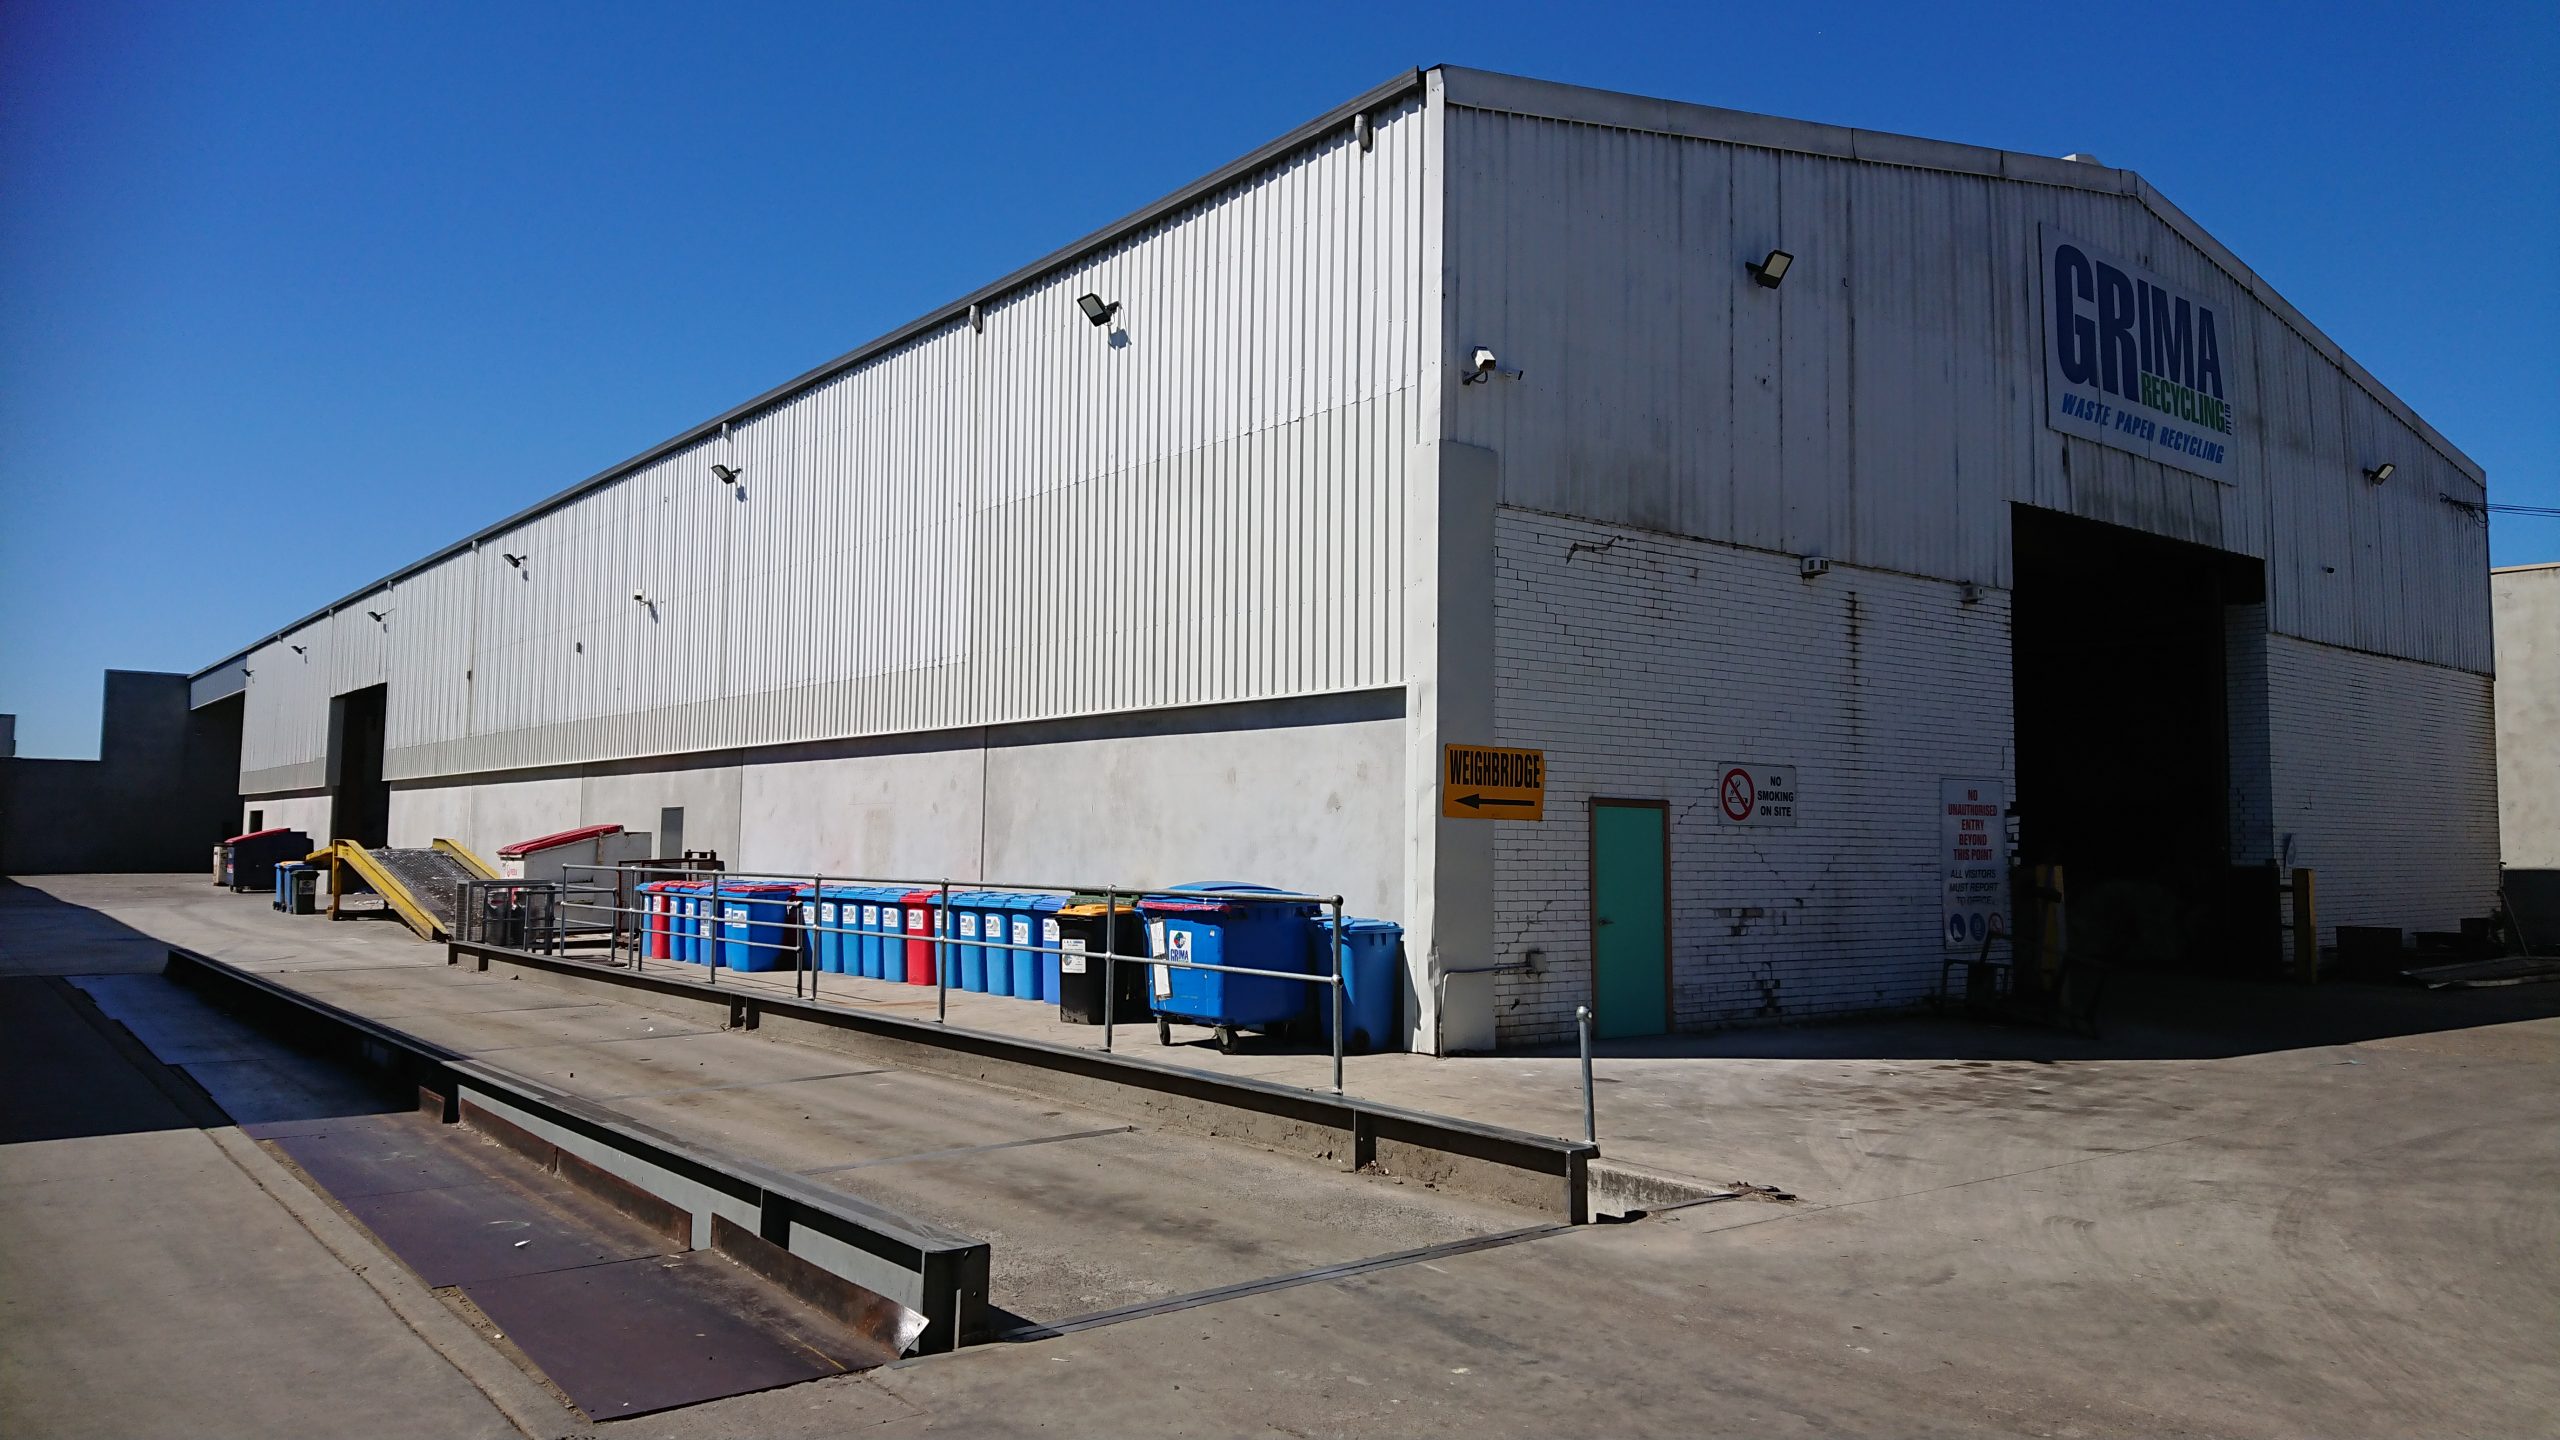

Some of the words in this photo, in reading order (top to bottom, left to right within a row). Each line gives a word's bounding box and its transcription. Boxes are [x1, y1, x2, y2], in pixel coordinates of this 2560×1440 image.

[2054, 244, 2224, 402] GRIMA
[2141, 371, 2226, 434] RECYCLING
[2061, 392, 2112, 426] WASTE
[2115, 410, 2155, 441] PAPER
[2159, 426, 2225, 464] RECYCLING
[1449, 749, 1540, 789] WEIGHBRIDGE
[1770, 776, 1782, 787] NO
[1757, 790, 1794, 802] SMOKING
[1967, 789, 1978, 801] NO
[1760, 805, 1772, 816] ON
[1774, 806, 1792, 817] SITE
[1948, 803, 1998, 817] UNAUTHORISED
[1961, 819, 1985, 831] ENTRY
[1958, 833, 1988, 846] BEYOND
[1953, 849, 1970, 861] THIS
[1971, 849, 1993, 861] POINT
[1950, 869, 1963, 879] ALL
[1964, 869, 1997, 879] VISITORS
[1949, 882, 1968, 892] MUST
[1969, 882, 2000, 892] REPORT
[1170, 948, 1189, 962] GRIMA
